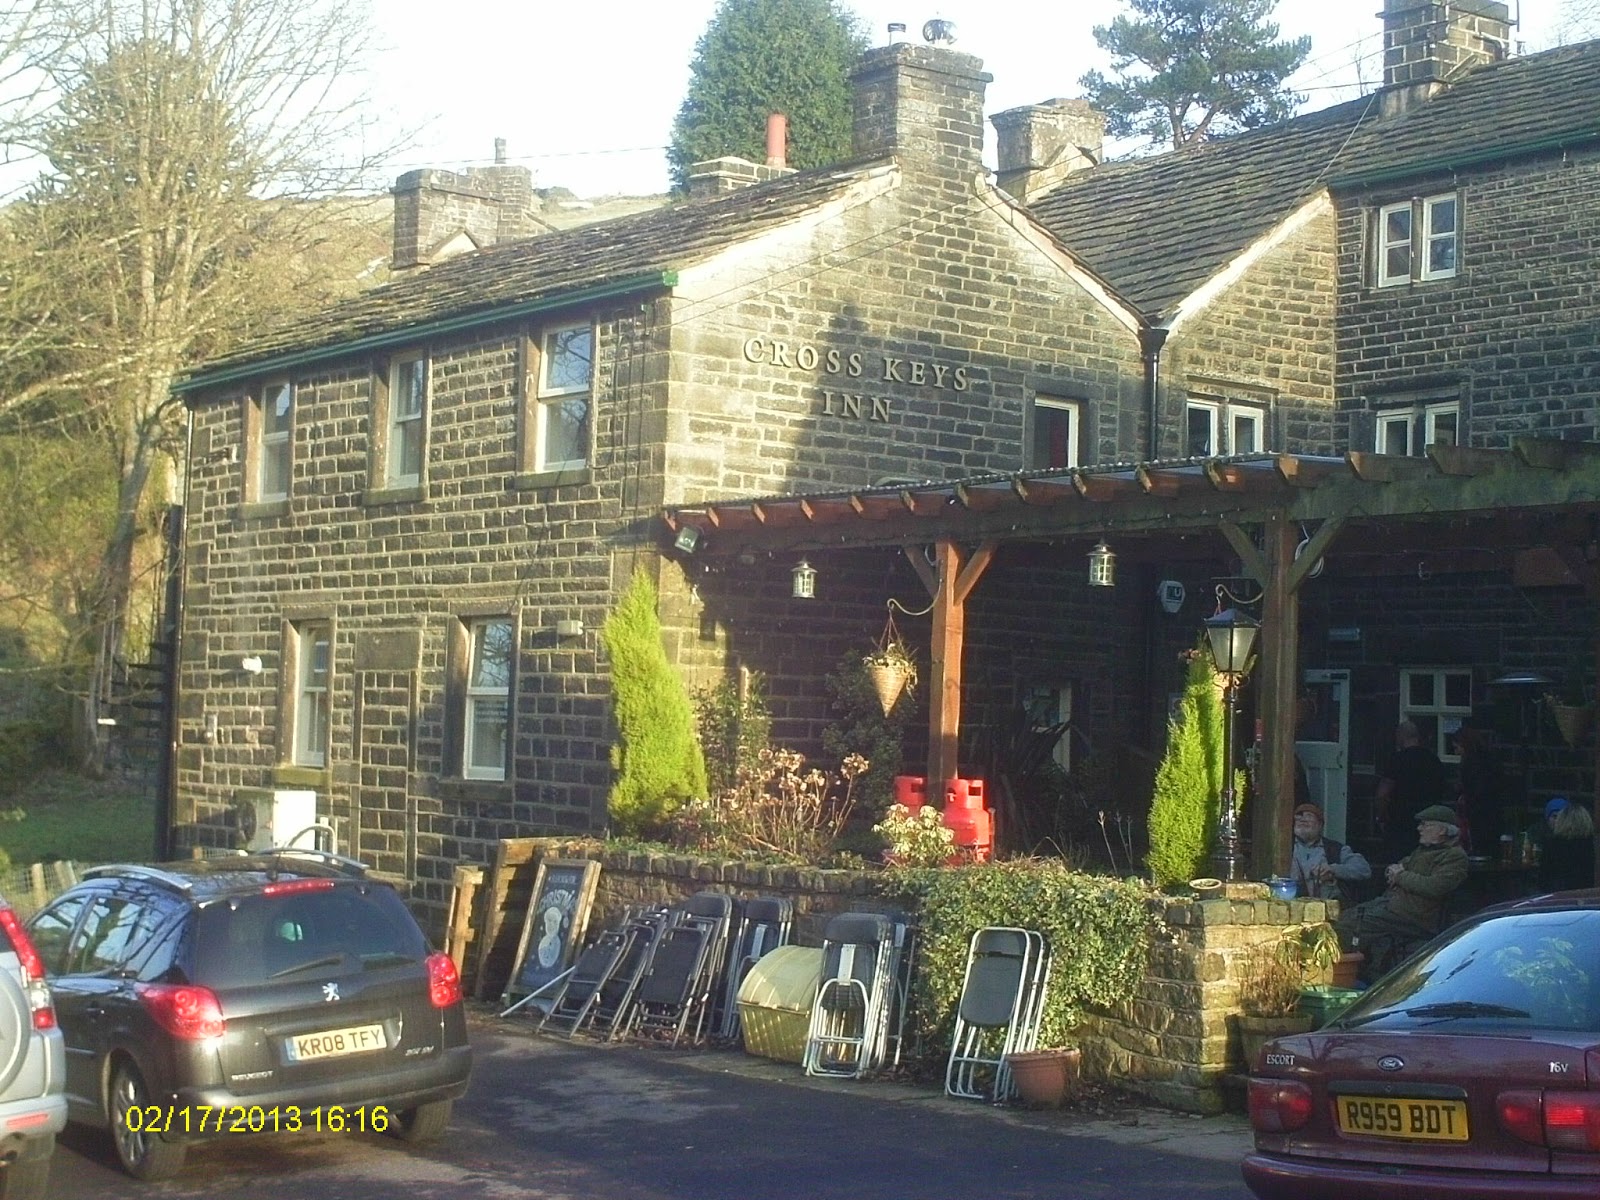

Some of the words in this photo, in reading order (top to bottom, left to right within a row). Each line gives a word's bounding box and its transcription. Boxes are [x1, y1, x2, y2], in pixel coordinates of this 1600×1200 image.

[744, 338, 862, 376] CROSS
[883, 357, 968, 391] KEYS
[823, 391, 892, 422] INN
[298, 1034, 345, 1057] KR08
[348, 1029, 380, 1049] TFY
[1266, 1054, 1296, 1066] ESCORT
[1346, 1101, 1402, 1132] R959
[1408, 1104, 1456, 1134] BDT
